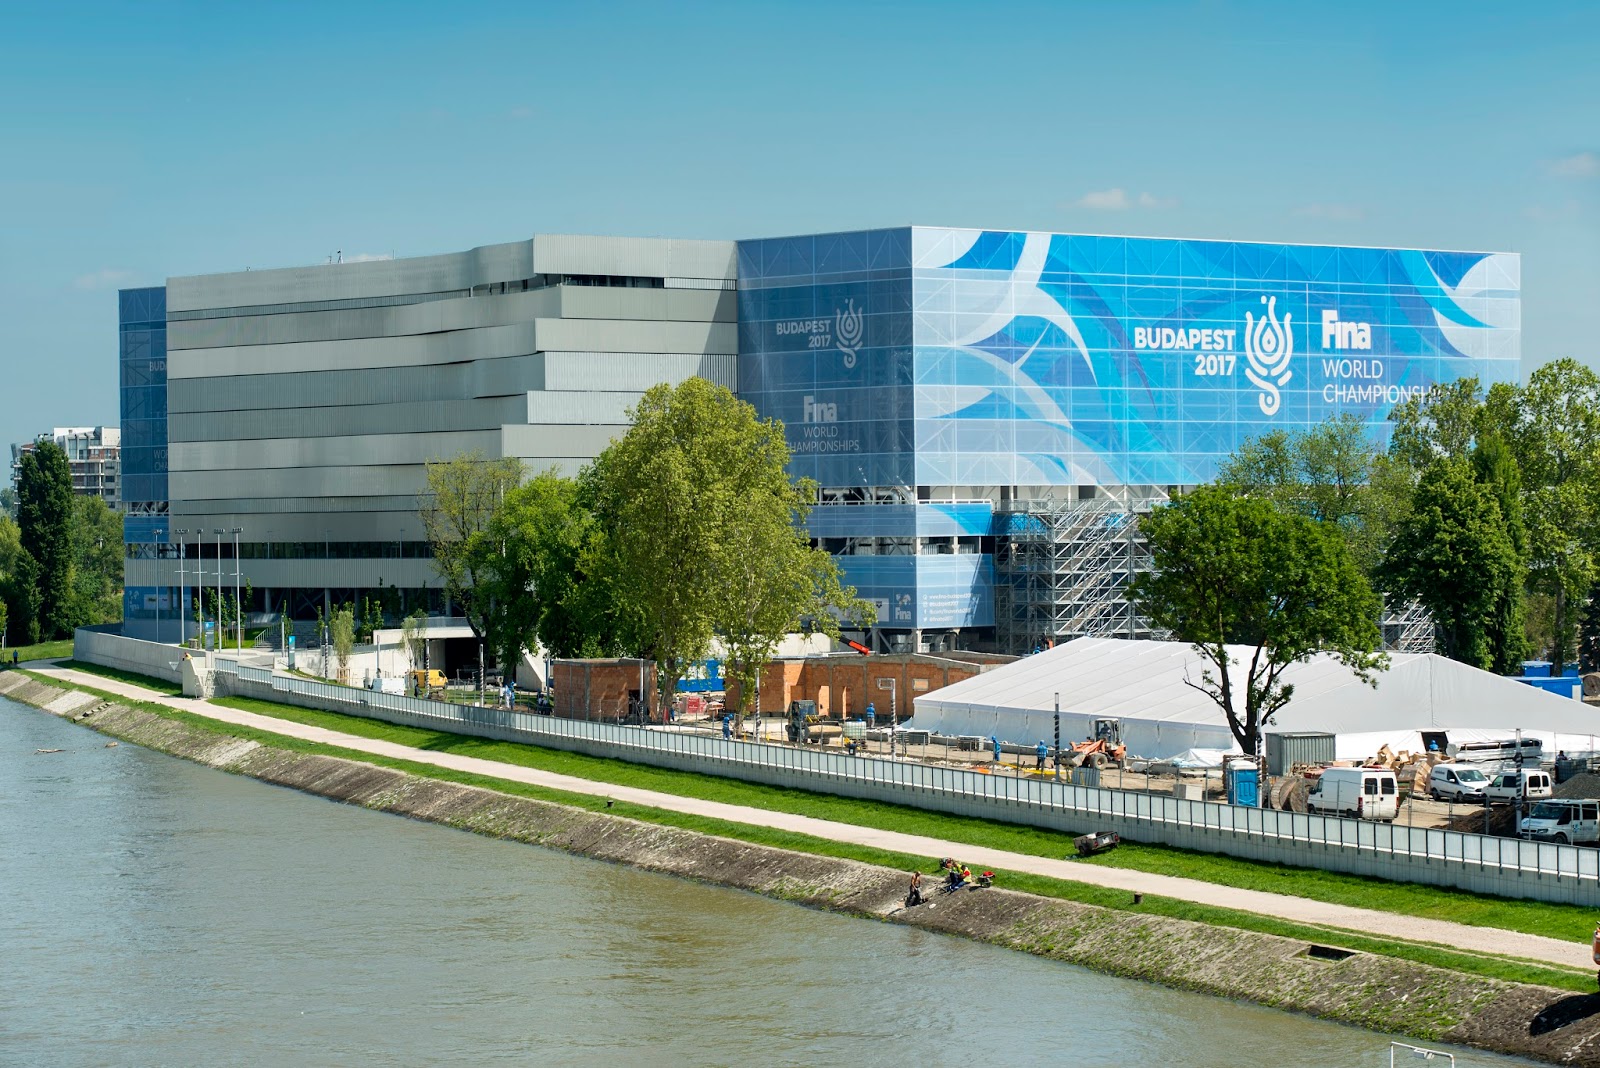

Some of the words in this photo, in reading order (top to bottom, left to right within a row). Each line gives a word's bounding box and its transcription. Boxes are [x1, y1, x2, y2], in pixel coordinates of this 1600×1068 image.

[776, 320, 831, 335] BUDAPEST
[808, 335, 831, 348] 2017
[1134, 327, 1236, 351] BUDAPEST
[149, 361, 167, 372] BUD
[1194, 354, 1236, 376] 2017
[1322, 359, 1383, 379] WORLD
[1323, 384, 1442, 404] CHAMPIONSHI
[803, 426, 839, 439] WORLD
[785, 439, 860, 454] HAMPIONSHIPS
